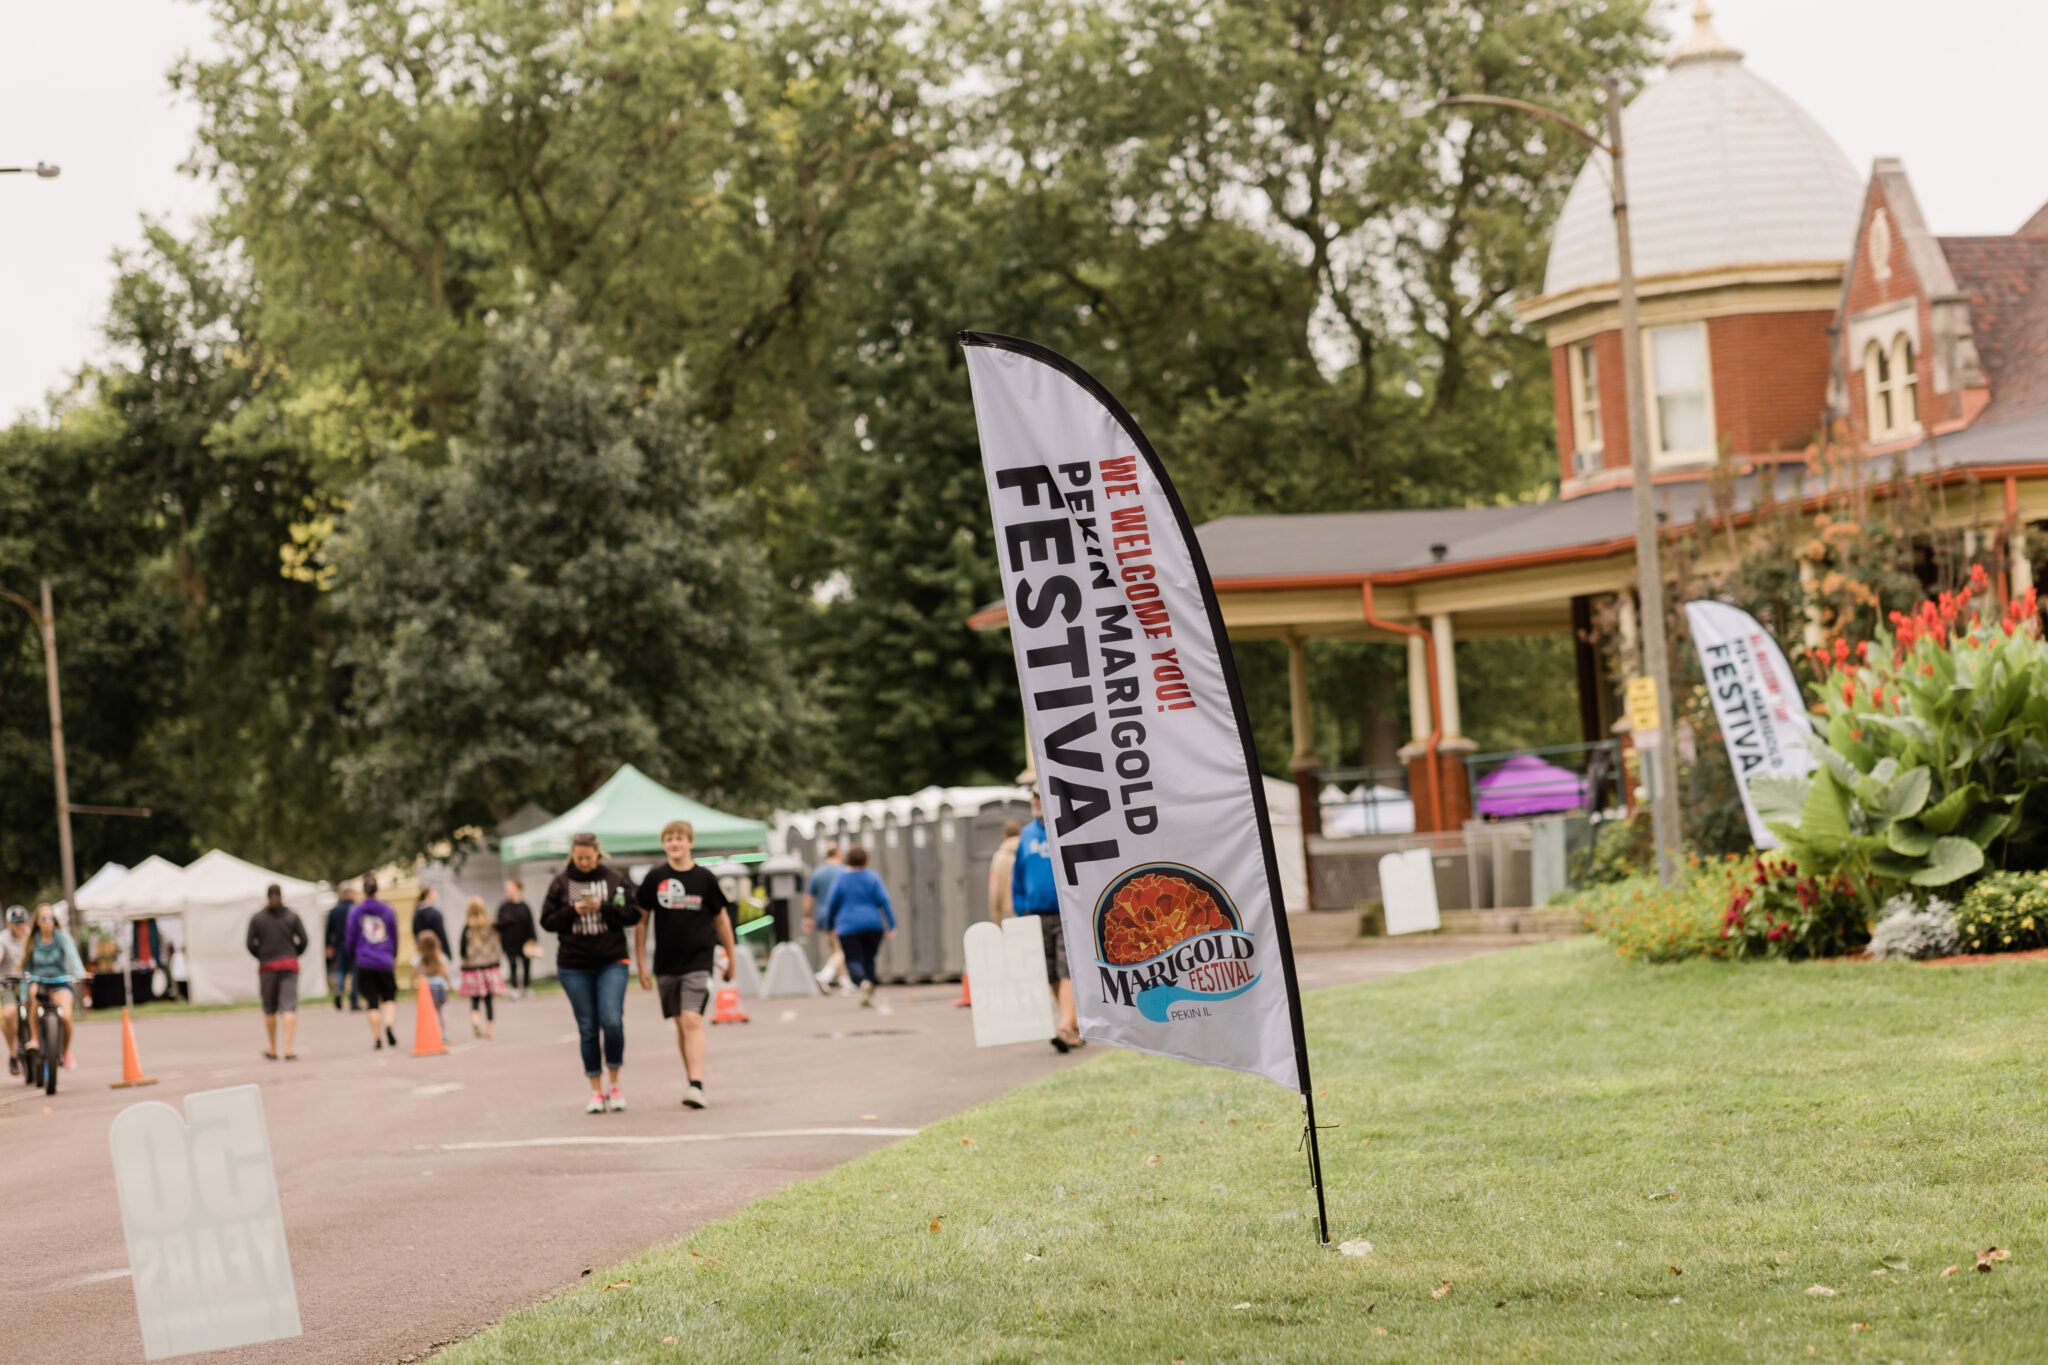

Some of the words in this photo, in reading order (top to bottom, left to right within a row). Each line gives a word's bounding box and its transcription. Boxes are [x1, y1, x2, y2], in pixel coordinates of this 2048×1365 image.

[1098, 455, 1140, 499] WE
[1110, 505, 1173, 640] WELCOME
[995, 464, 1120, 886] FESTIVAL
[1058, 460, 1118, 590] PEKIN
[1095, 604, 1159, 836] MARIGOLD
[1150, 647, 1197, 713] YOU!
[1704, 642, 1765, 789] FESTIVA
[1097, 935, 1255, 1007] MARIGOLD
[1188, 960, 1255, 992] FESTIVAL
[1171, 1008, 1201, 1021] PEKIN
[1202, 1006, 1212, 1017] IL
